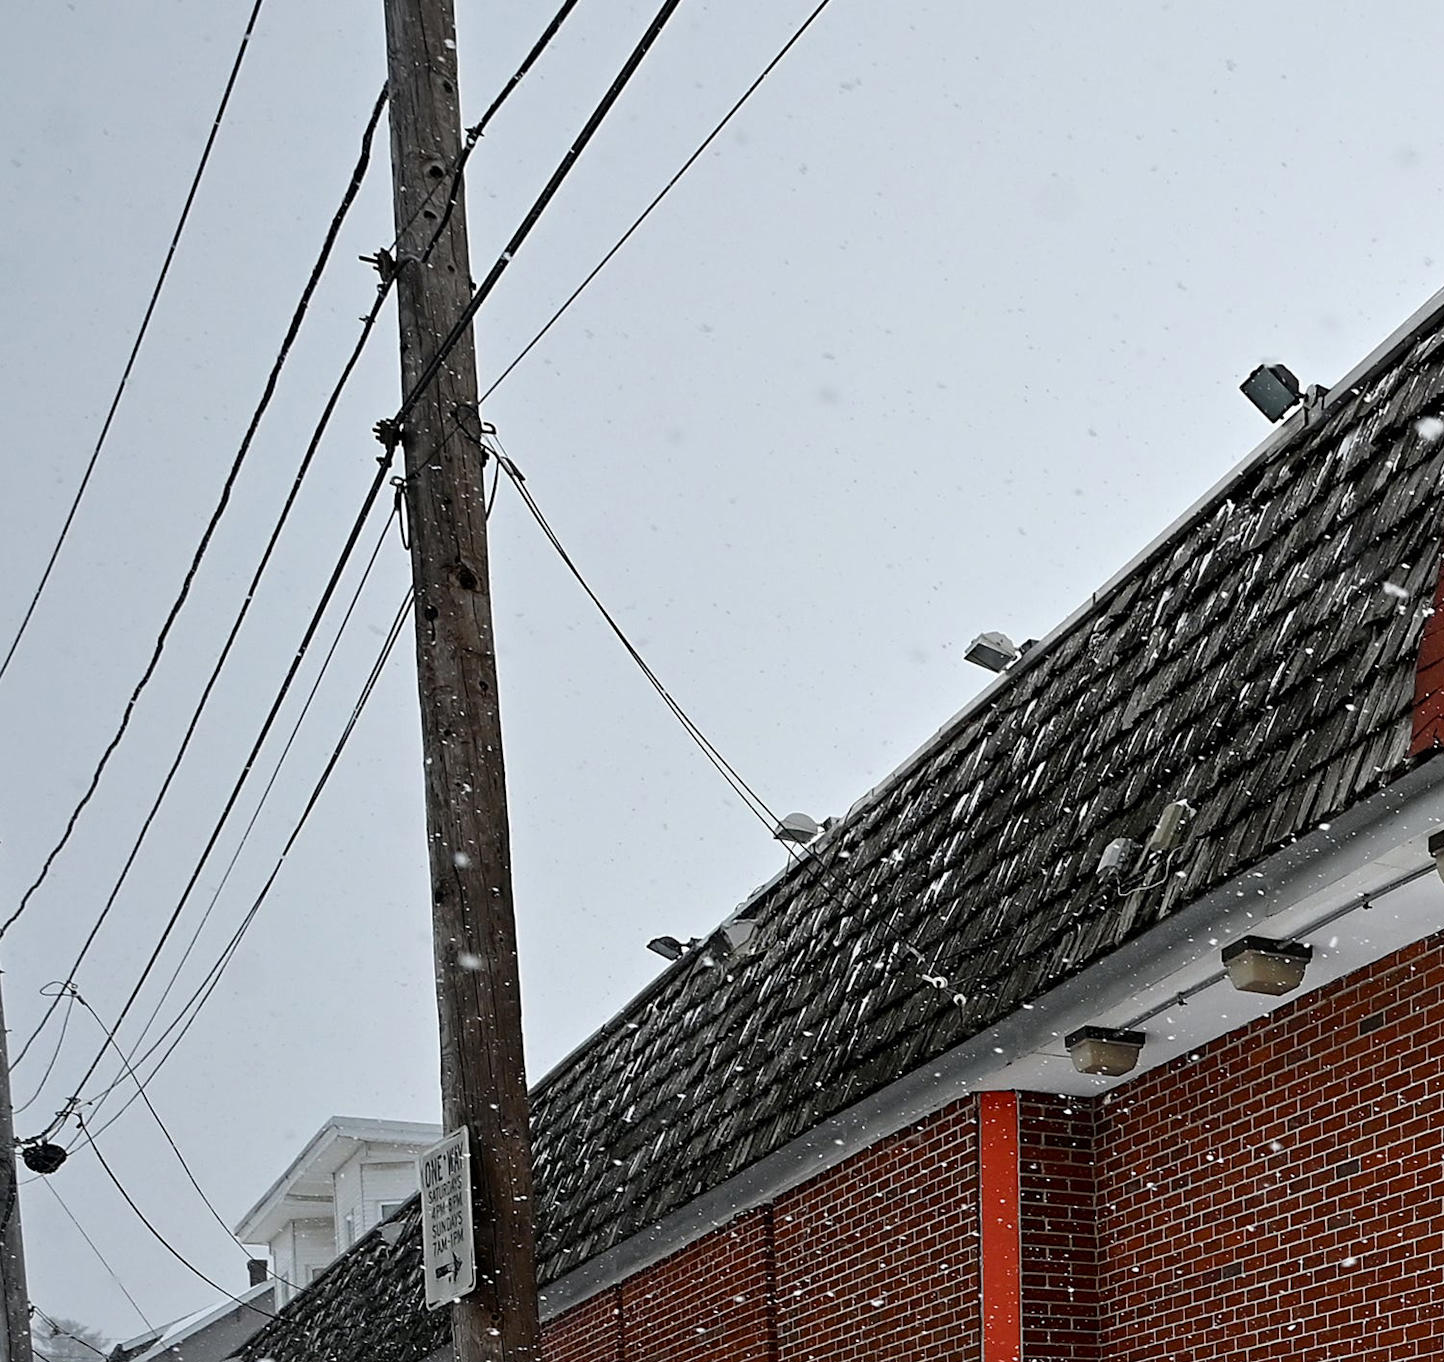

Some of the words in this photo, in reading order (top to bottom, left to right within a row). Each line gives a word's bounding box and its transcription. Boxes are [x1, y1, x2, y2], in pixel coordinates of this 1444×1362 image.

[425, 1154, 443, 1188] ONE
[446, 1142, 463, 1175] WAY
[428, 1174, 462, 1204] SATURDAYS
[432, 1210, 463, 1239] SUNDAYS
[432, 1227, 464, 1257] 7AM-1PM
